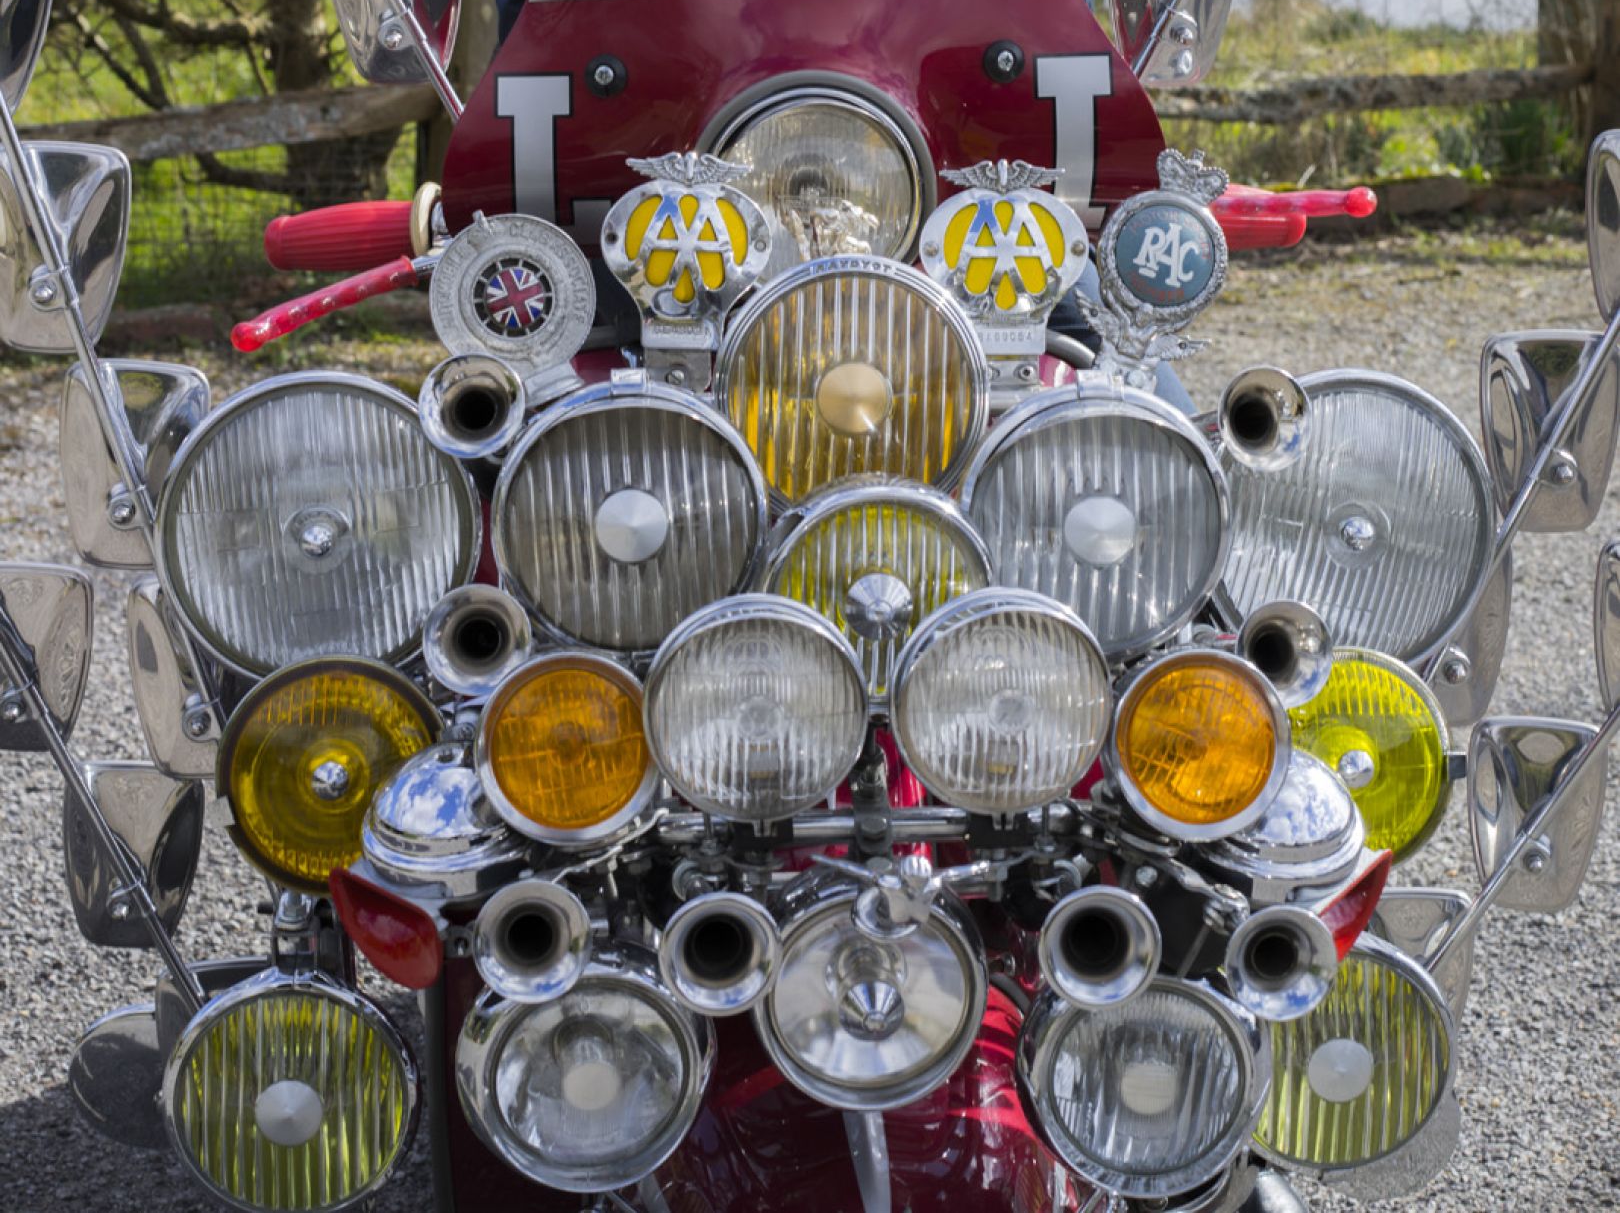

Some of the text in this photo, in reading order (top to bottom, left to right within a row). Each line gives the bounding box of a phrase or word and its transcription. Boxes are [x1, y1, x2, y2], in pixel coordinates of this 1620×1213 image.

[641, 191, 738, 293] AA
[954, 195, 1054, 293] AA
[1132, 222, 1199, 287] RAC
